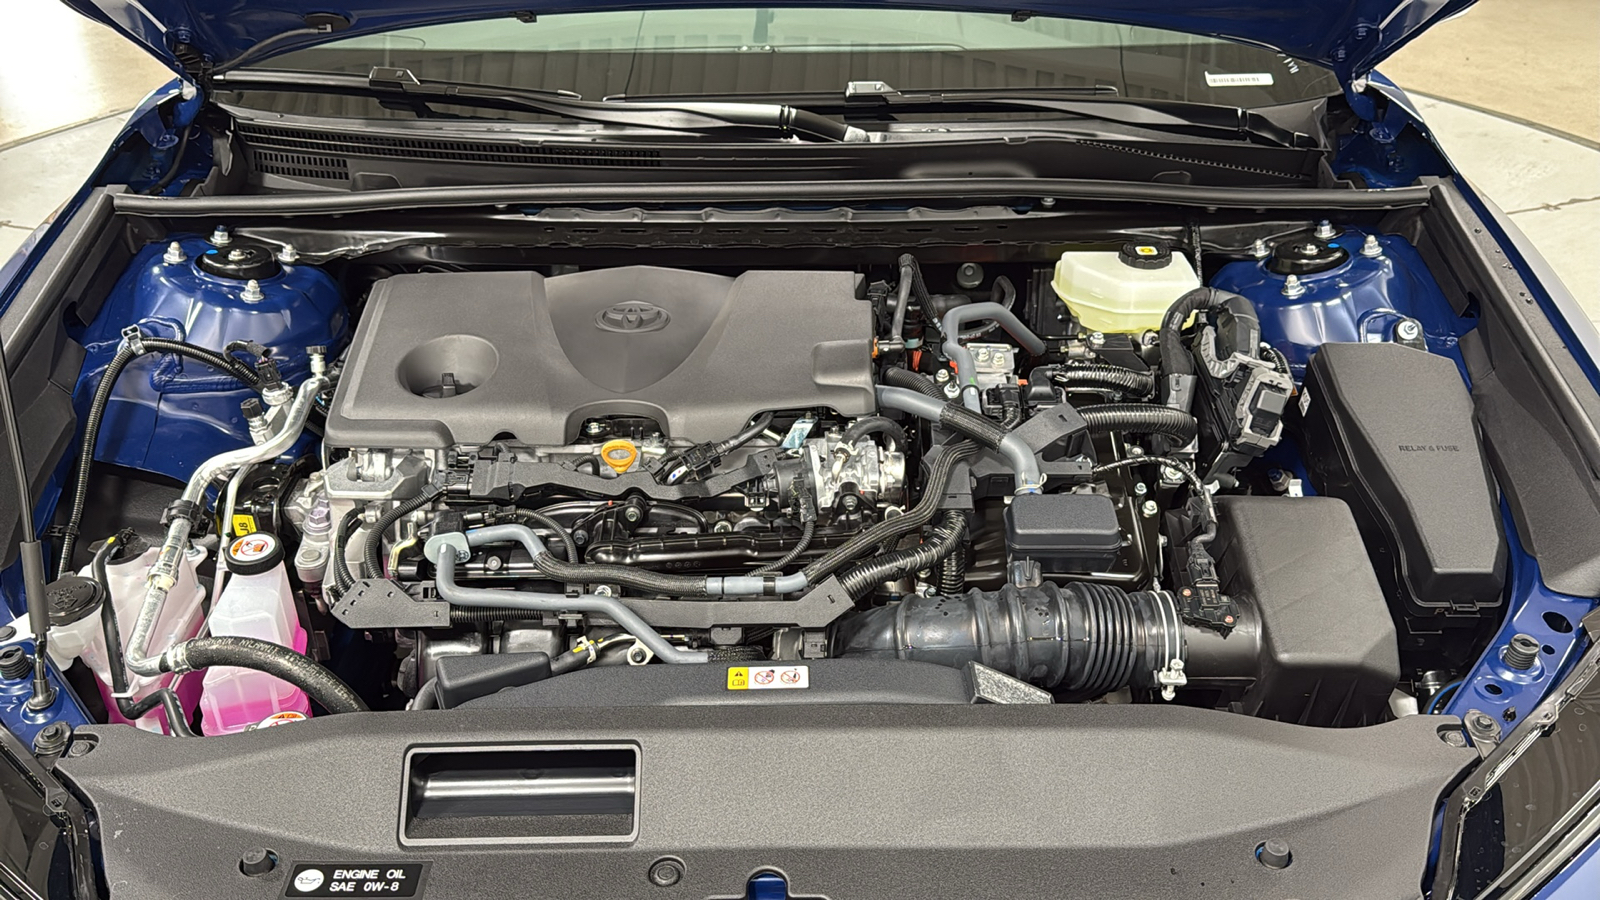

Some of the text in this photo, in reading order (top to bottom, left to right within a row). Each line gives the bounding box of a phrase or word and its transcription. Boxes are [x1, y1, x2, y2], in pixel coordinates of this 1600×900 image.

[333, 869, 406, 879] ENGINE OIL
[329, 882, 400, 892] SAE 0W-8
